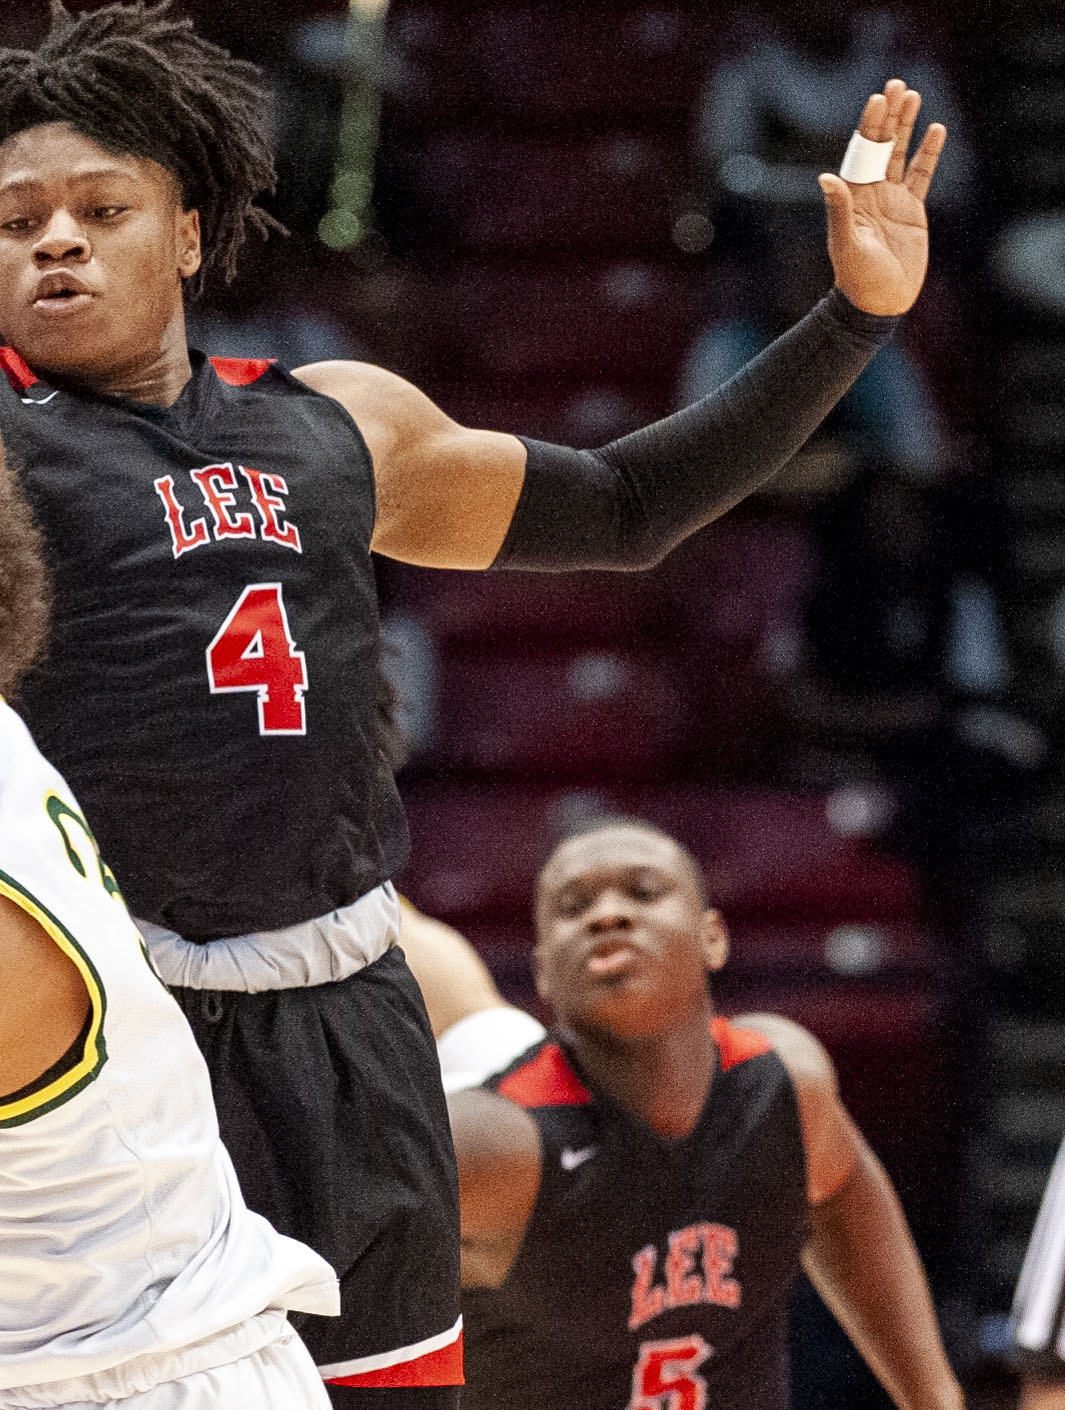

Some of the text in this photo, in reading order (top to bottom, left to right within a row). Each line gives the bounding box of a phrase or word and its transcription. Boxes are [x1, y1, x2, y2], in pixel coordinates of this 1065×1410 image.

[153, 462, 303, 559] LEE
[206, 582, 308, 735] 4
[628, 1221, 742, 1332] LEE
